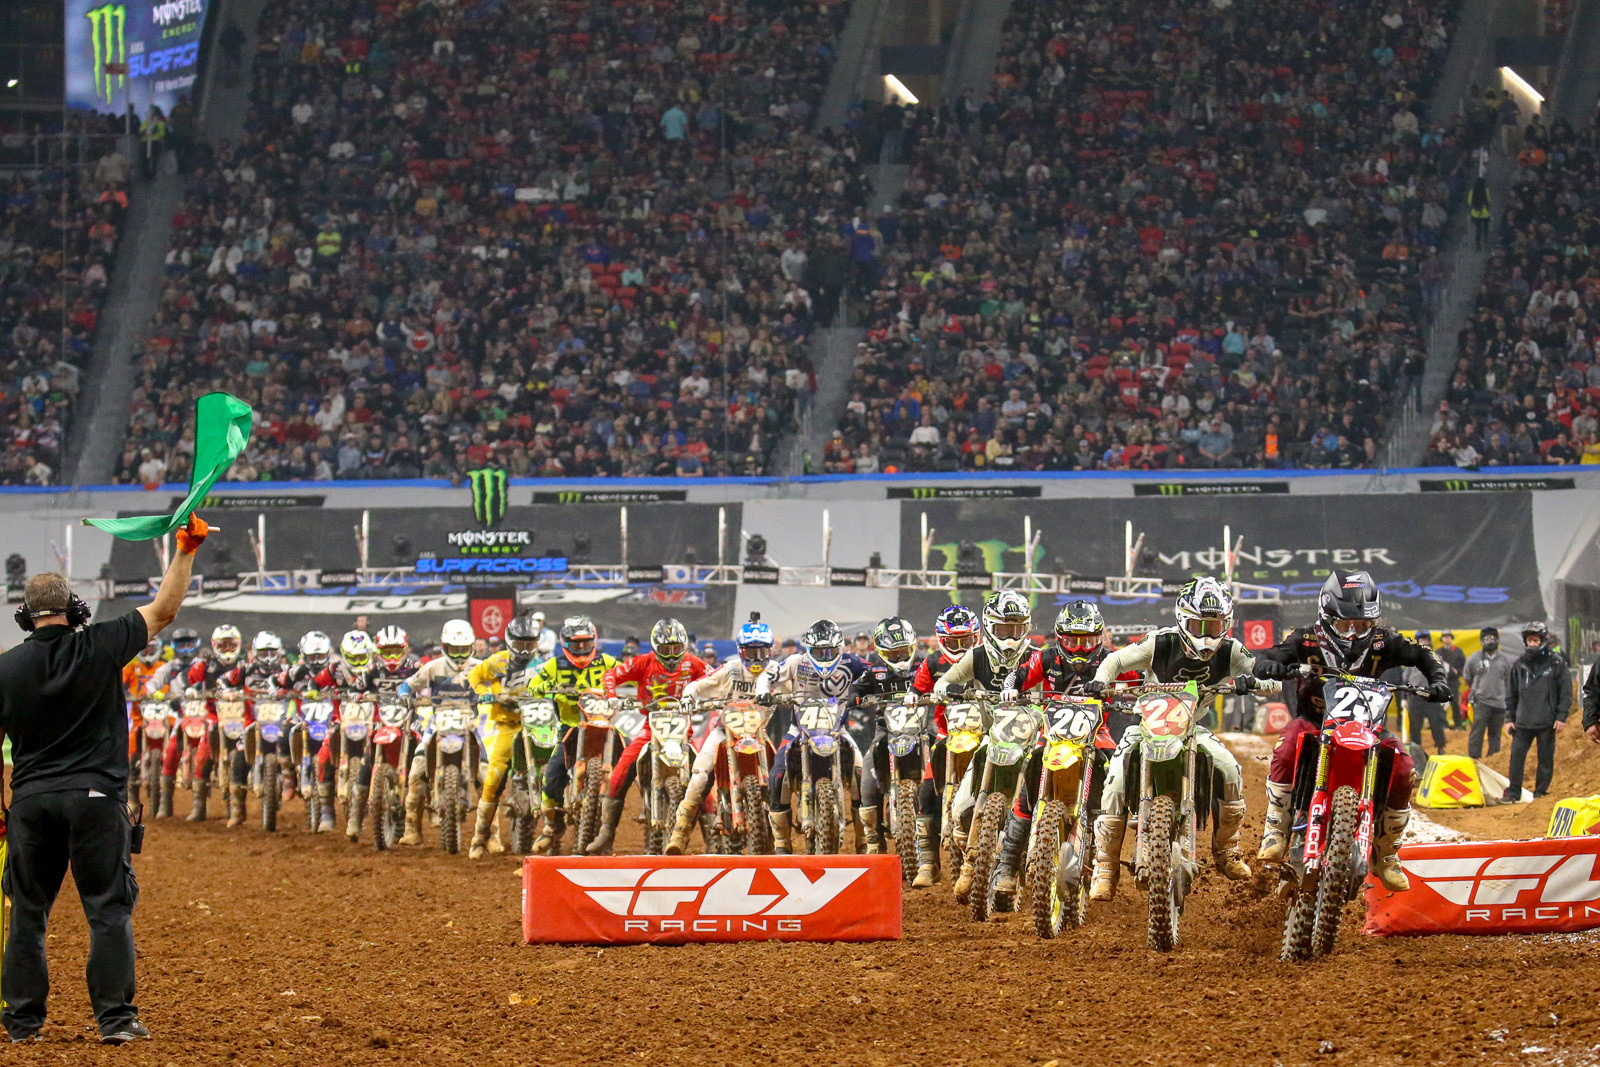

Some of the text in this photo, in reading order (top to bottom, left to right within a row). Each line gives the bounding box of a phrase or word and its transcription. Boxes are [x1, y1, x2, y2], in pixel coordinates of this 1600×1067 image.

[448, 530, 531, 546] MONSTER
[460, 546, 520, 554] ENERGY
[1158, 546, 1396, 569] MONSTER
[416, 557, 568, 573] SUPERCROSS
[303, 703, 333, 721] 70
[523, 703, 553, 720] 56
[725, 711, 763, 735] 28
[800, 706, 835, 730] 45
[890, 705, 925, 731] 32
[1049, 708, 1096, 738] 26
[1144, 698, 1190, 735] 24
[652, 717, 687, 739] 52
[993, 710, 1034, 740] 73
[556, 868, 870, 915] FLY
[624, 919, 802, 932] RACING
